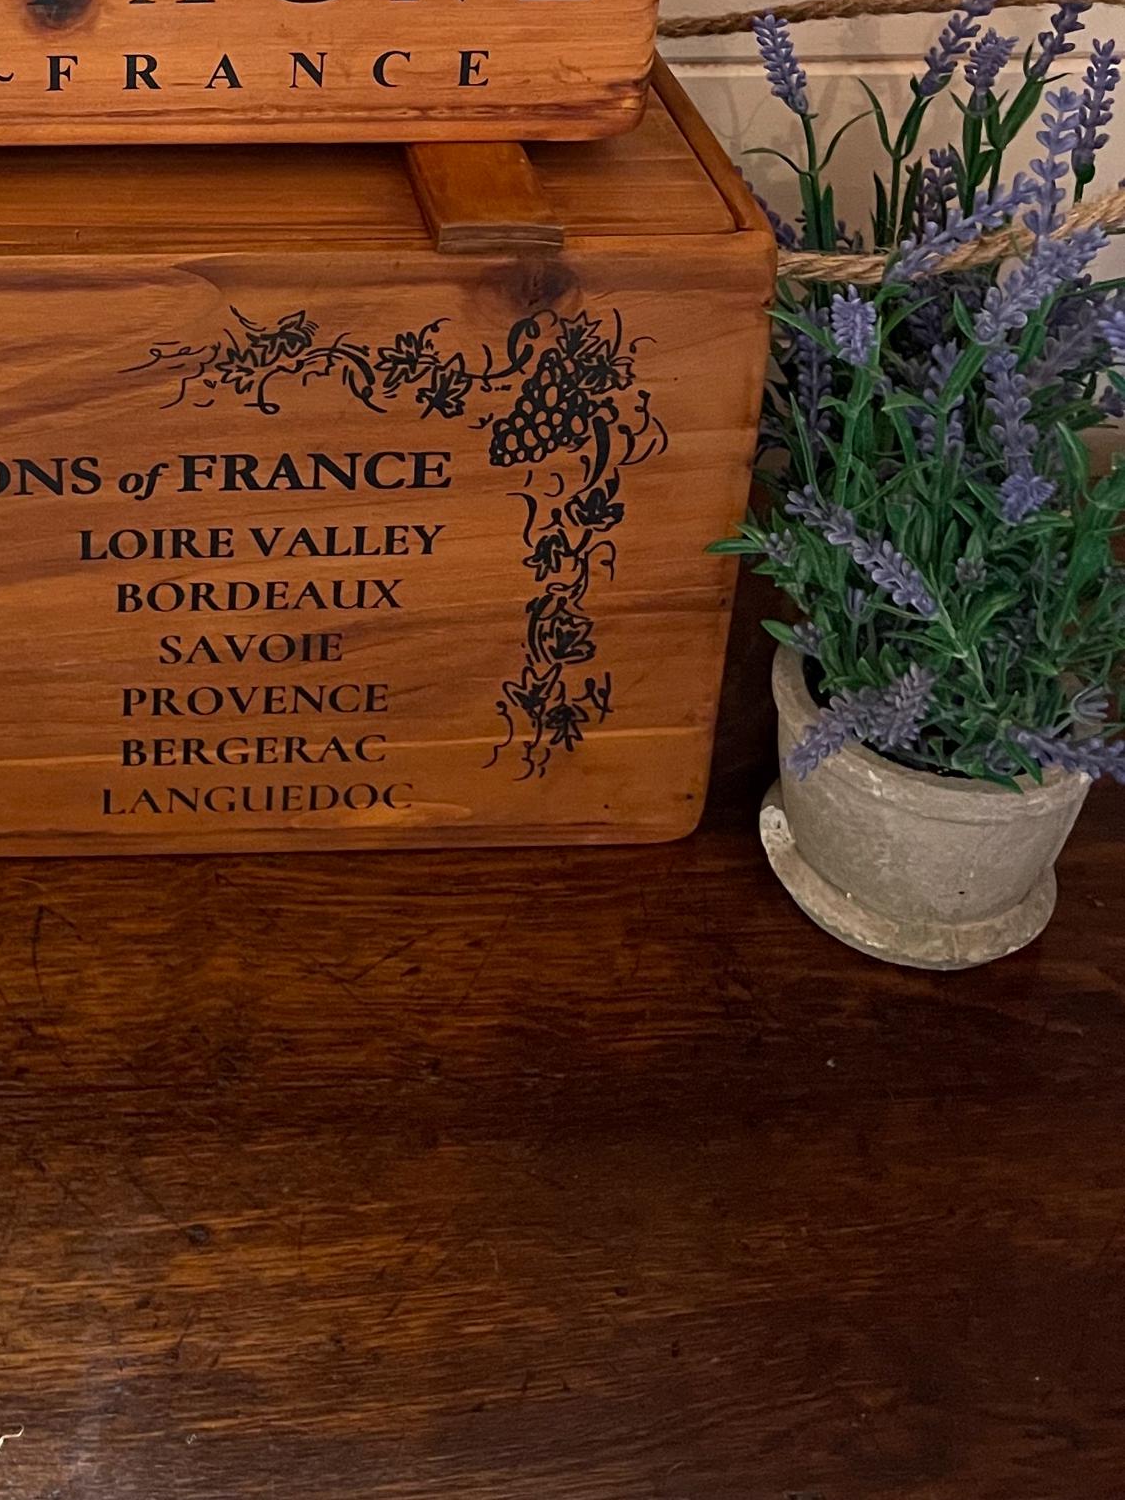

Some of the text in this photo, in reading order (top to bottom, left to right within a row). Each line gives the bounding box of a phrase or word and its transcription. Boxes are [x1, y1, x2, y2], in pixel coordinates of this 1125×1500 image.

[117, 462, 170, 501] of
[176, 450, 453, 493] FRANCE
[78, 524, 447, 562] LOIRE VALLEY
[115, 578, 405, 614] BORDEAUX
[158, 632, 344, 666] SAVOIE
[121, 682, 389, 717] PROVENCE
[120, 733, 388, 768] BERGERAC
[101, 781, 414, 817] LANGUEDOC
